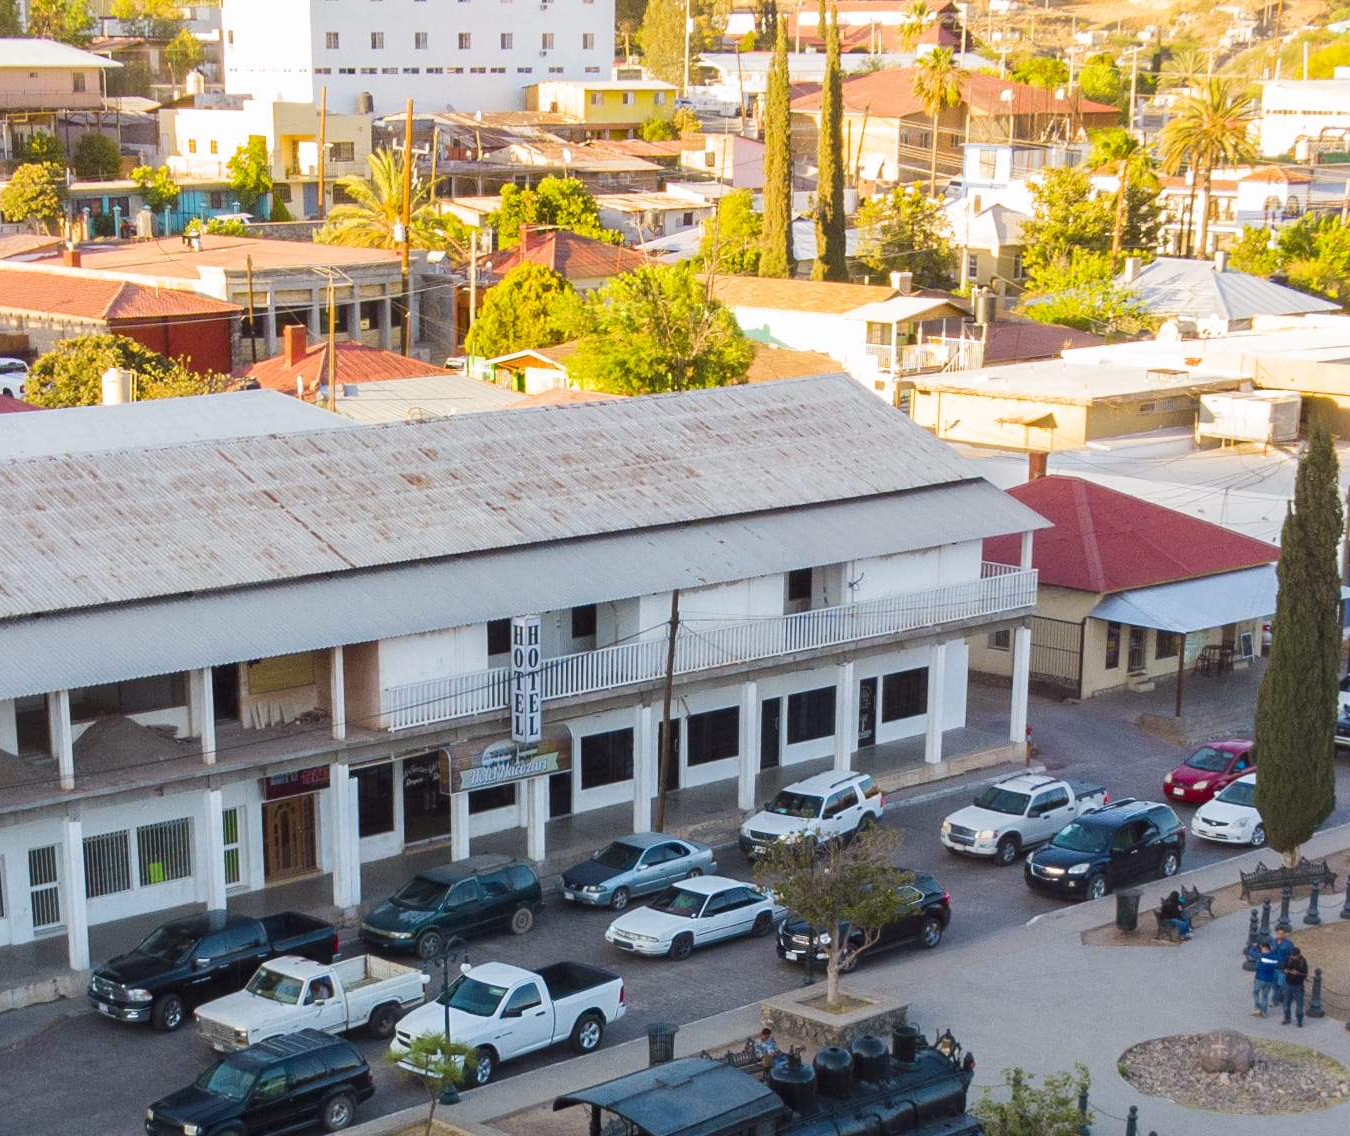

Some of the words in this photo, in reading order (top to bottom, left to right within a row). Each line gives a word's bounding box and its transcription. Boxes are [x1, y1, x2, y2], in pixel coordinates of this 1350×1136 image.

[513, 624, 524, 736] HOTEL
[527, 624, 539, 736] HOTEL
[499, 758, 548, 779] Nacozari
